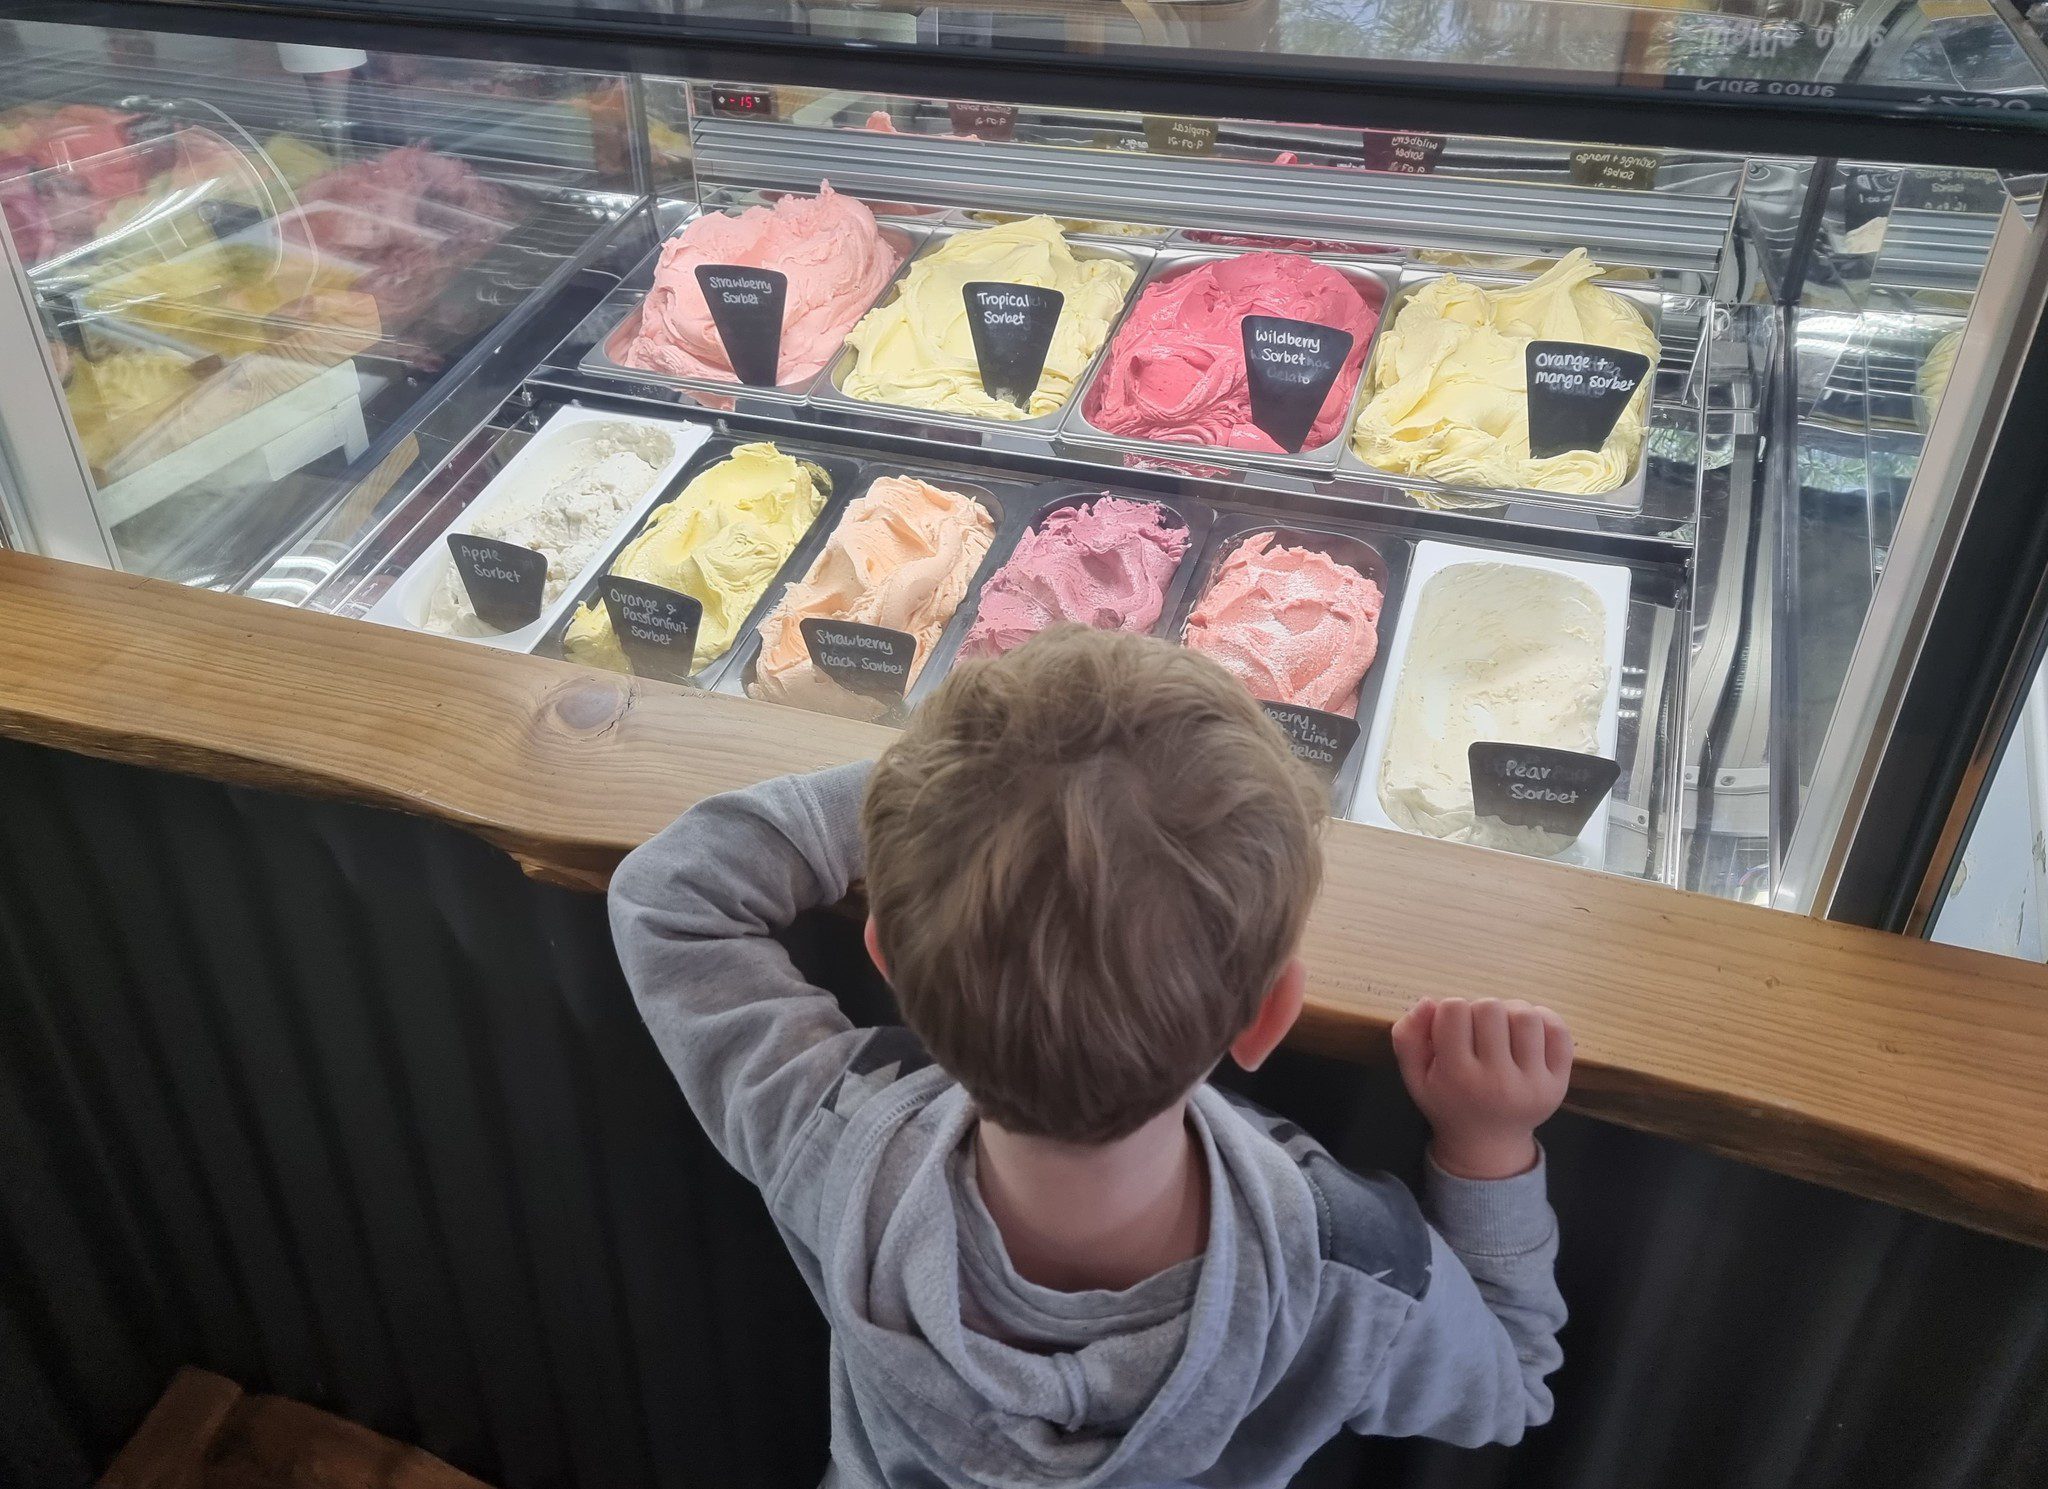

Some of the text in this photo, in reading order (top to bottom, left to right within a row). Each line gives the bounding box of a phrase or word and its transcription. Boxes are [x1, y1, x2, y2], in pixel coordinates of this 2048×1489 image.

[709, 276, 773, 294] Strawberry
[722, 292, 759, 305] Sorbet
[976, 292, 1030, 310] Tropical
[983, 310, 1026, 326] Sorbet
[1255, 329, 1321, 354] Wildberry
[1261, 348, 1306, 365] Sorbet
[1535, 352, 1590, 372] Orange
[1535, 371, 1584, 389] mango
[461, 545, 502, 563] Apple
[473, 563, 521, 584] Sorbet
[610, 588, 660, 615] Orange
[622, 606, 689, 634] Passionfruit
[631, 625, 672, 645] Sorbet
[816, 629, 894, 655] Strawberry
[820, 651, 904, 675] Peach Sorbet
[1301, 730, 1338, 749] Lime
[1505, 759, 1552, 780] Pear
[1510, 783, 1579, 804] Sorbet
